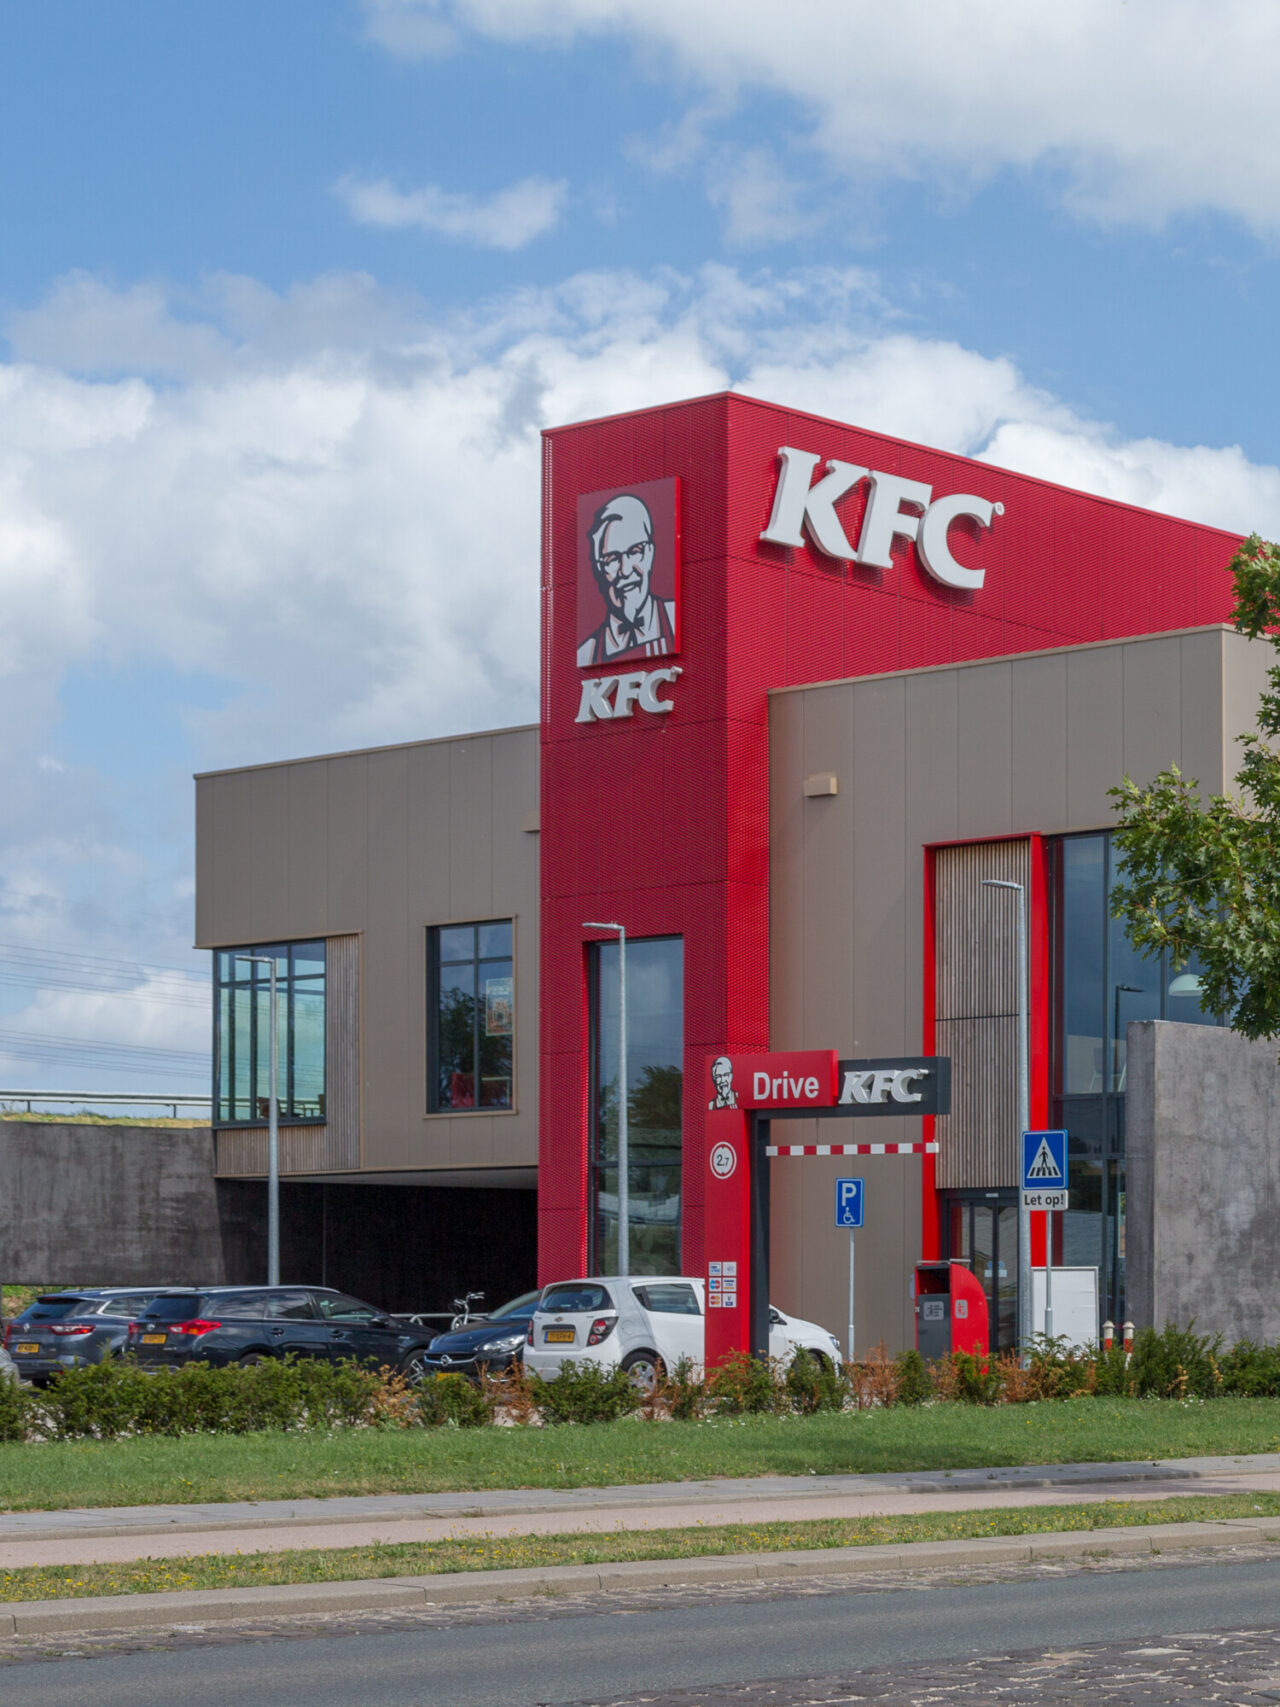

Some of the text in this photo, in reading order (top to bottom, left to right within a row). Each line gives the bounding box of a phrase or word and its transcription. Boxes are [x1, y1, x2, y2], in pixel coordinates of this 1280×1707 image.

[759, 446, 1005, 589] KFC
[574, 666, 683, 723] KFC
[753, 1071, 820, 1100] Drive
[838, 1069, 929, 1105] KFC
[842, 1183, 857, 1206] P
[1024, 1193, 1064, 1208] Let op!
